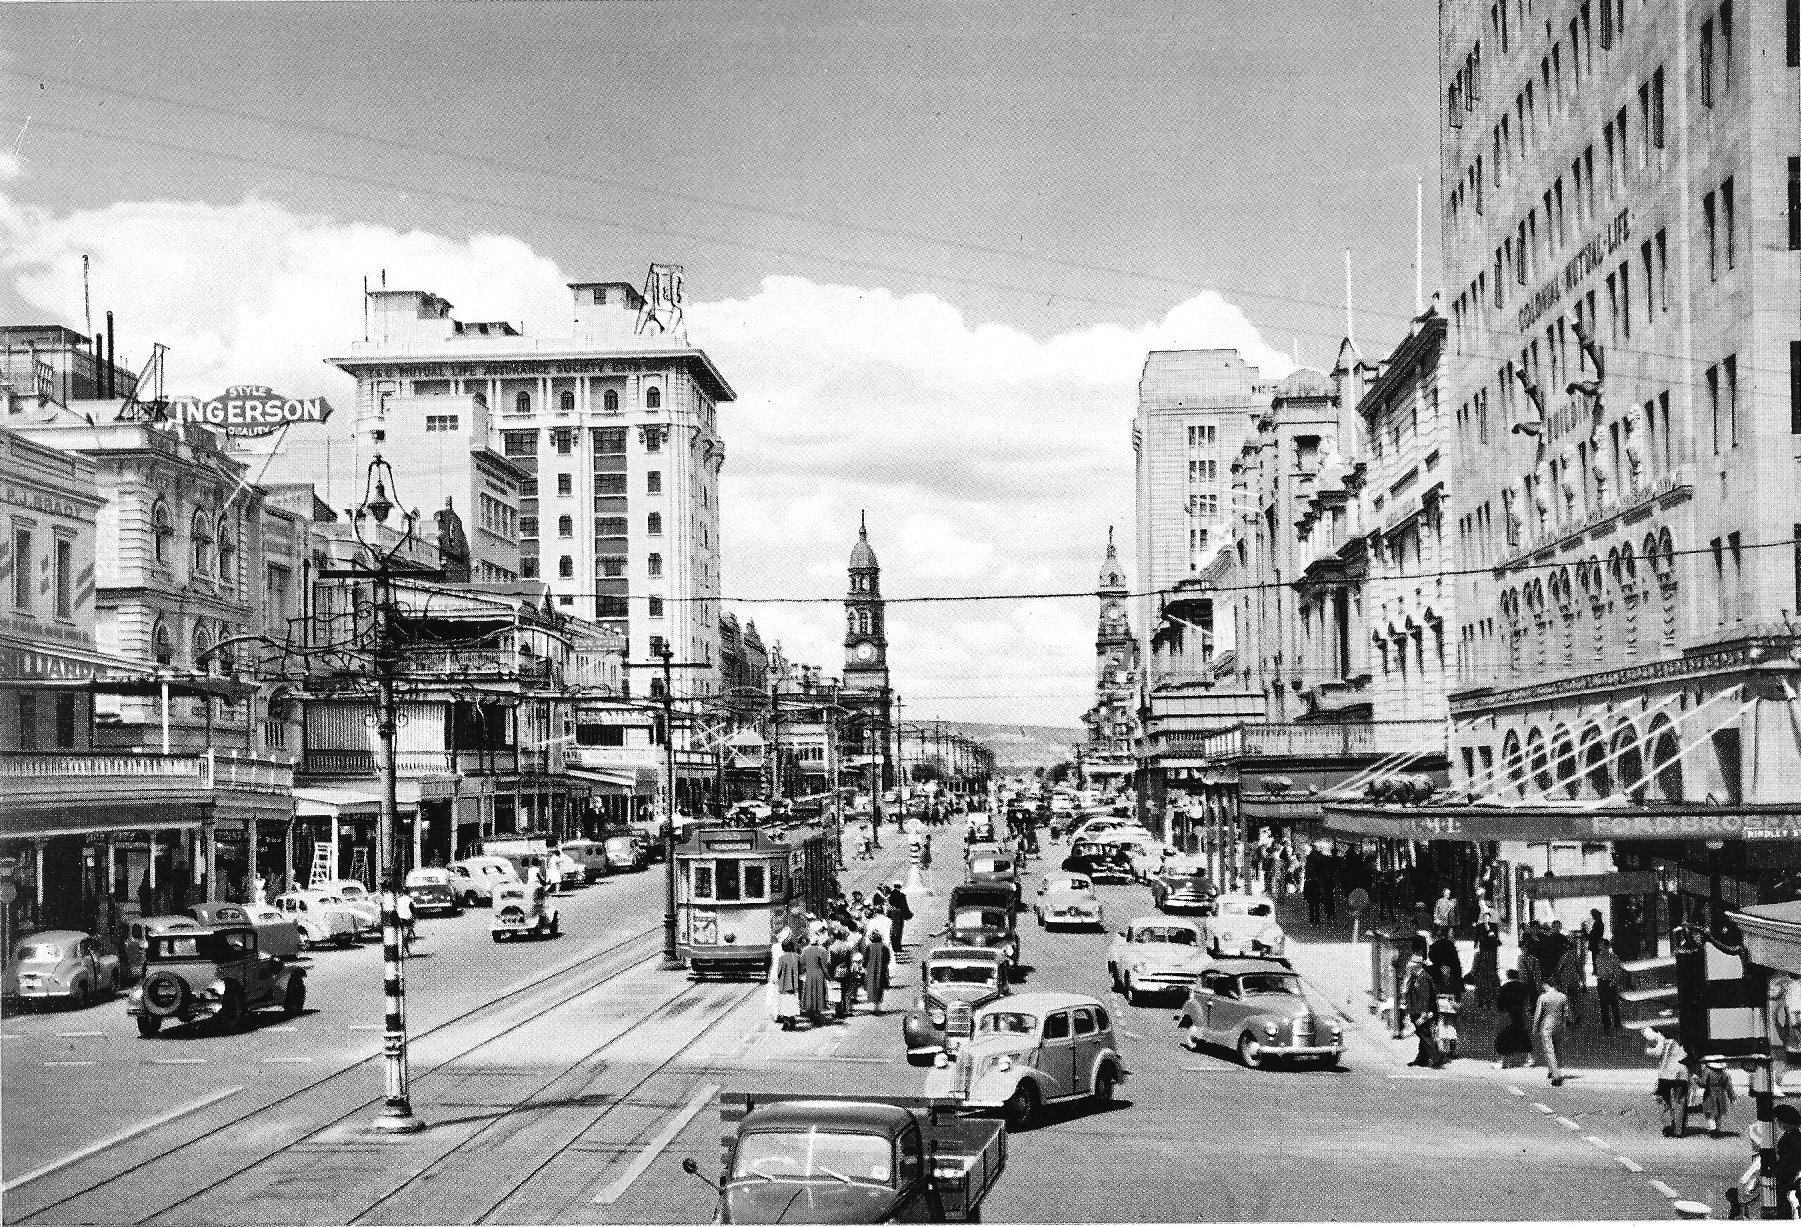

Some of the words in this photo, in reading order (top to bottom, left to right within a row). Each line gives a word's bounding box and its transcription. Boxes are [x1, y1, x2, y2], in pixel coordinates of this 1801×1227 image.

[1607, 207, 1630, 255] LIFE
[227, 385, 269, 397] STYLE
[175, 399, 321, 424] INGERSON
[227, 426, 270, 436] QUALITY
